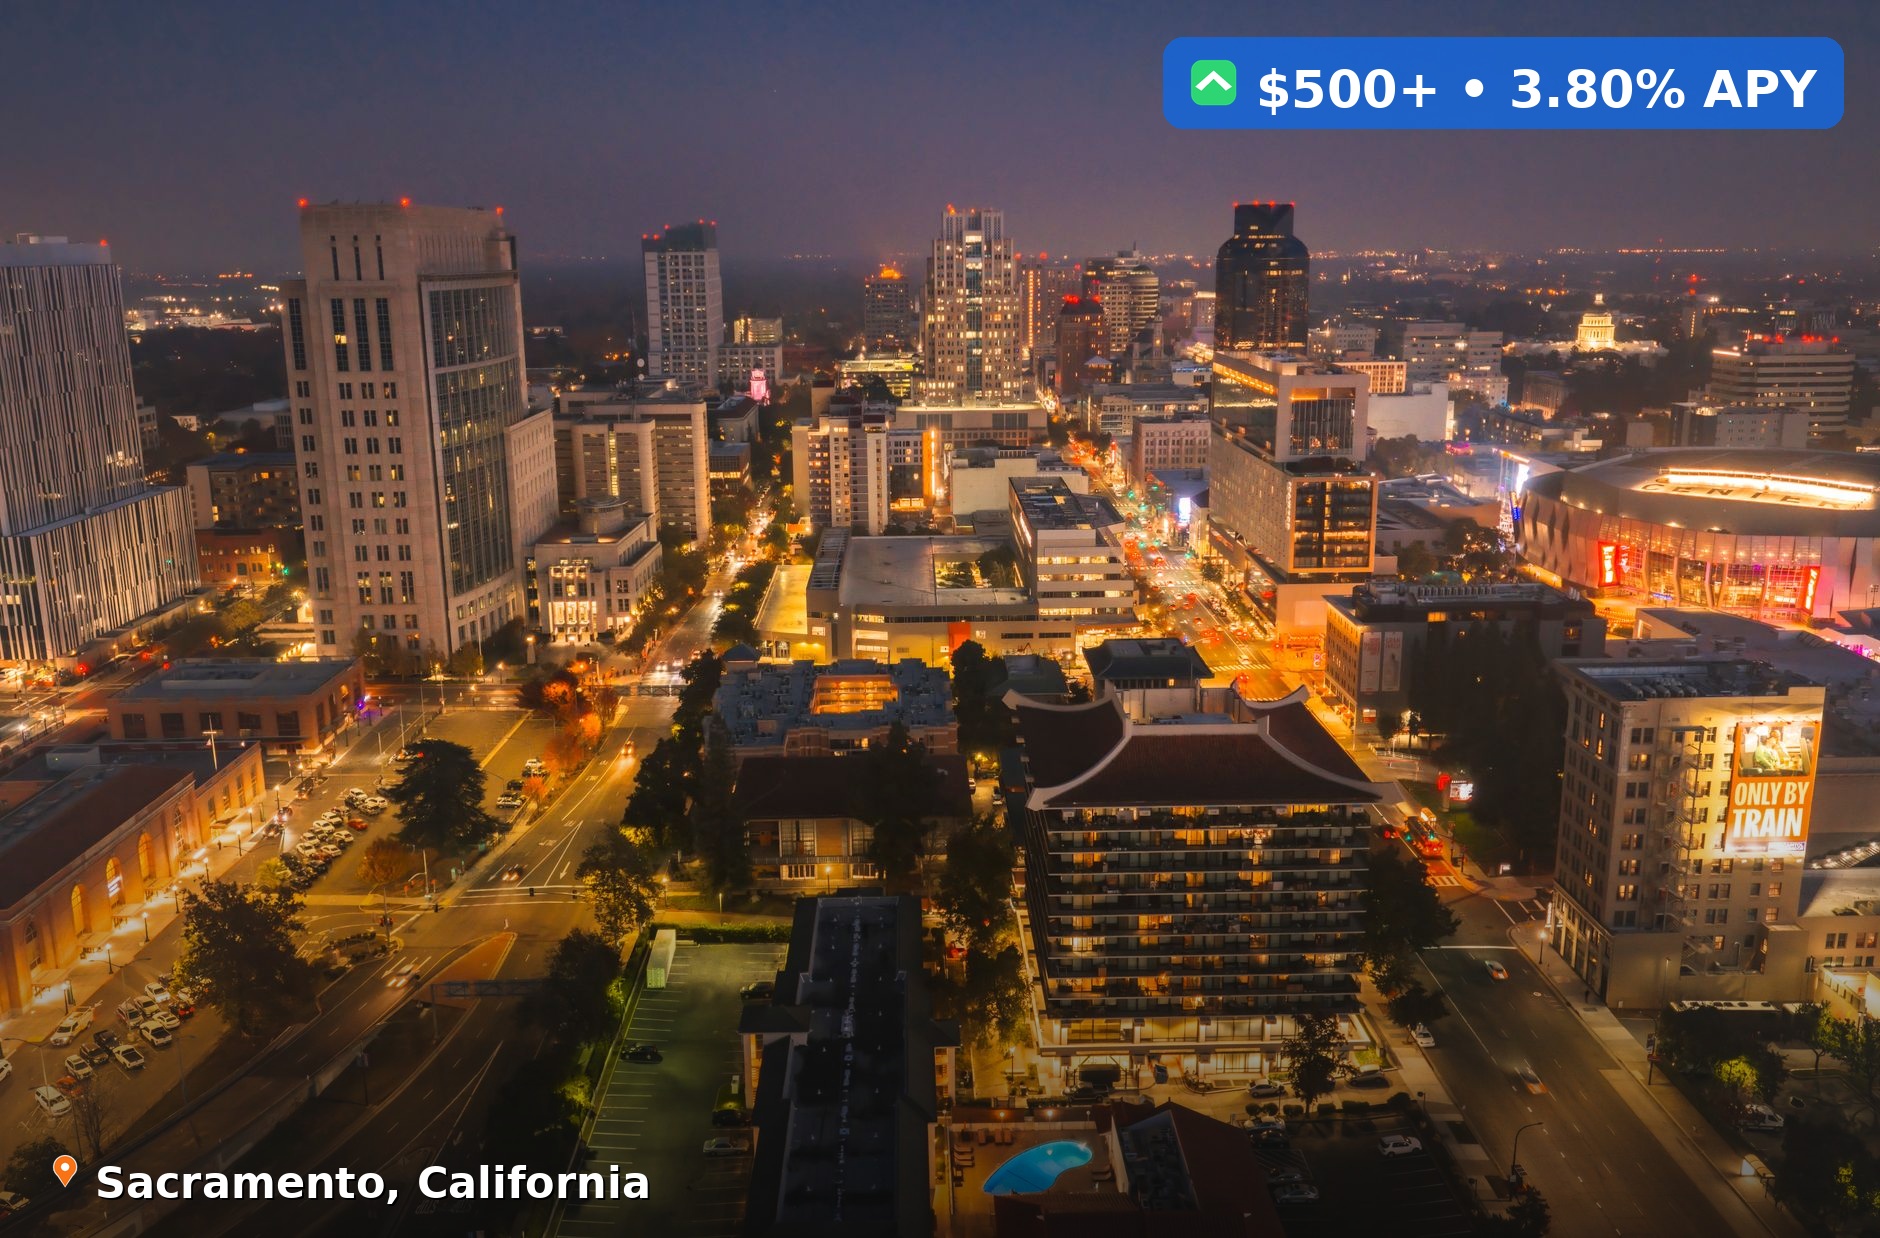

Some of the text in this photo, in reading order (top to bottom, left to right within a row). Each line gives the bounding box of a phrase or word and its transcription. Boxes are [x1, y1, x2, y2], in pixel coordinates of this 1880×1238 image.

[1734, 781, 1811, 806] ONLY BY
[1732, 807, 1804, 838] TRAIN
